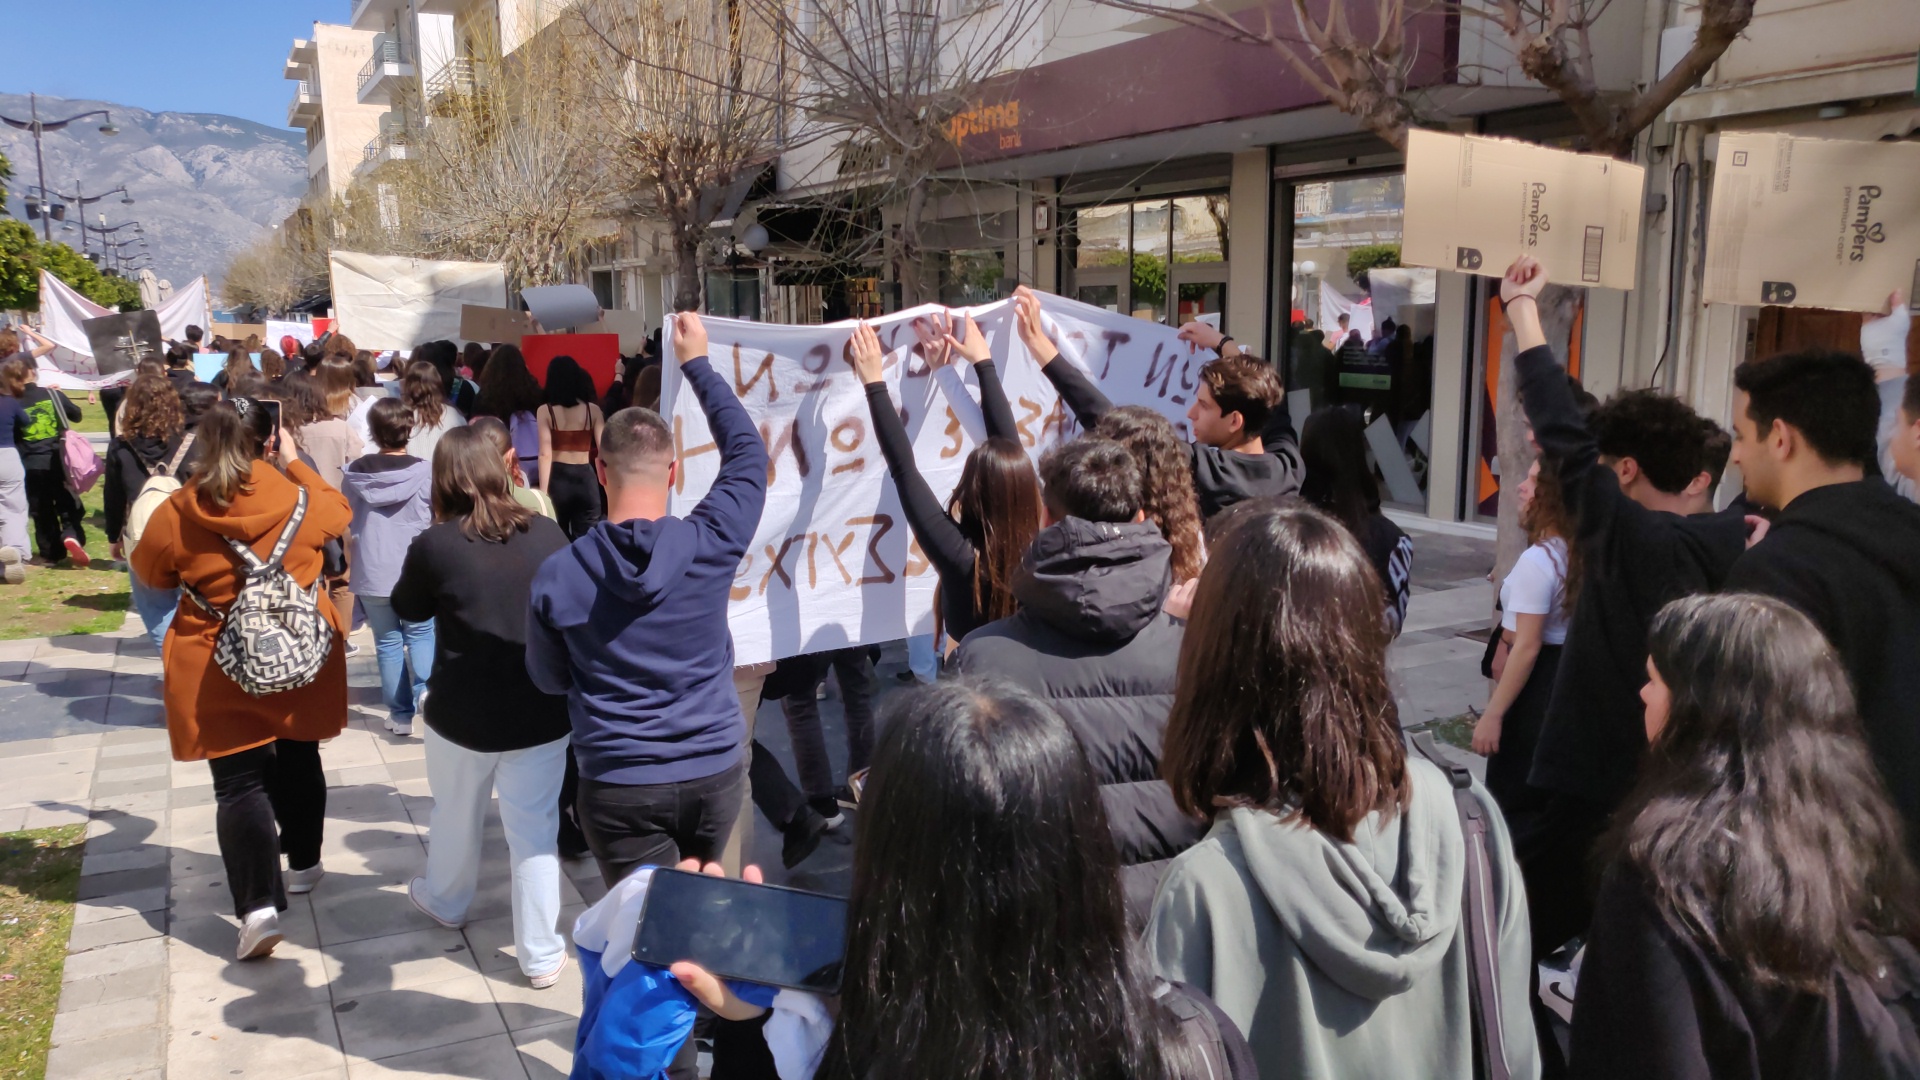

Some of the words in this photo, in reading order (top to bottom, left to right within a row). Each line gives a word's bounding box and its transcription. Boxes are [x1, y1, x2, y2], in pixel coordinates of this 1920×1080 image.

[999, 132, 1023, 150] bank
[1520, 182, 1528, 222] premium
[1528, 182, 1547, 247] Pampers
[1840, 186, 1852, 234] premium
[1849, 185, 1883, 262] Pampers
